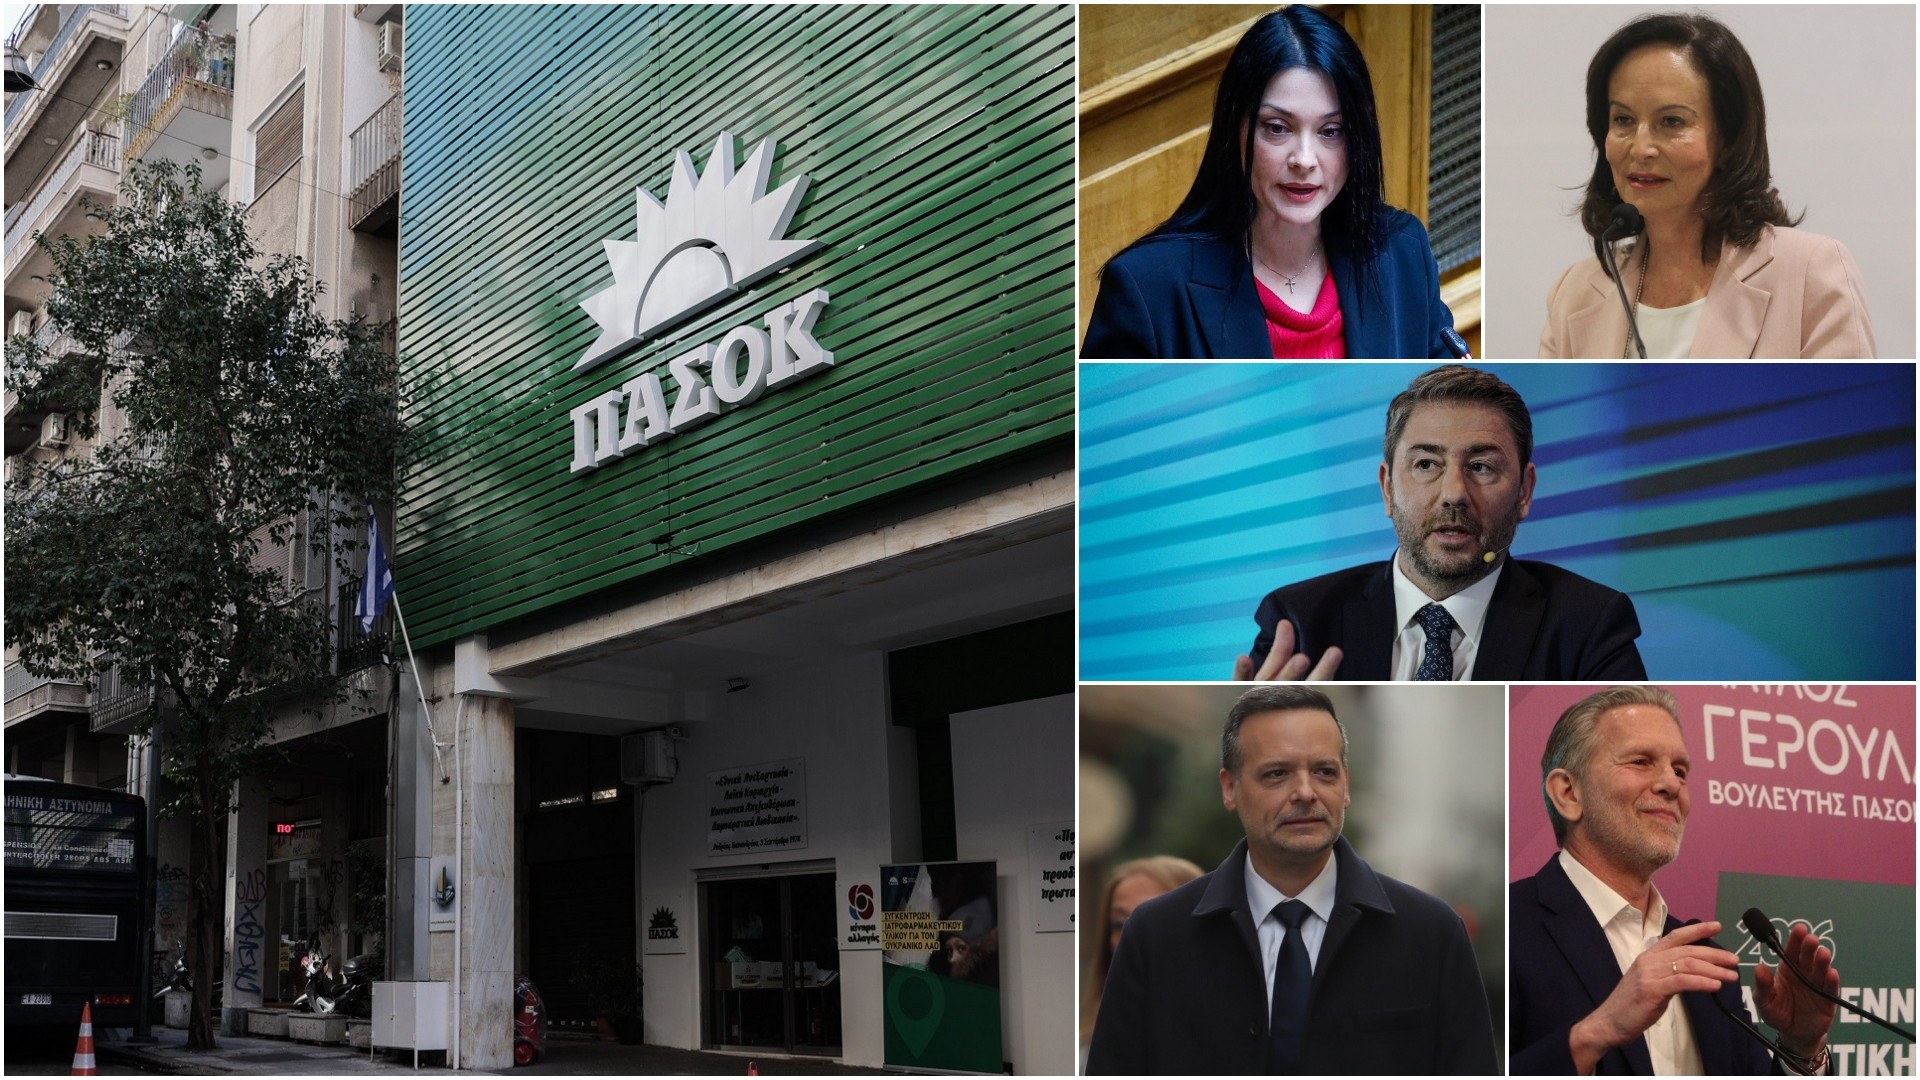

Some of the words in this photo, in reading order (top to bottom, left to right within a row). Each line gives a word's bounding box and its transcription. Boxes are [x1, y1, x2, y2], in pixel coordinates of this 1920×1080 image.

[570, 288, 833, 474] ΠΑΣΟΚ
[1703, 704, 1916, 785] ΓΕΡΟΥΛ
[743, 766, 789, 783] Ανεξαρτησία
[744, 783, 779, 799] Κυριαρχία
[1708, 779, 1847, 817] ΒΟΥΛΕΥΤΗΣ
[49, 798, 113, 814] ΑΣΤΥΝΟΜΙΑ
[710, 802, 744, 817] Κοινωνική
[745, 798, 796, 814] Απελευθέρωση
[711, 816, 755, 833] Δημοκρατική
[884, 911, 931, 921] ΣΥΓΚΕΝΤΡΩΣΗ
[849, 923, 876, 935] κίνημα
[884, 921, 962, 930] ΙΑΤΡΟΦΑΡΜΑΚΕΥΤΙΚΟΥ
[648, 928, 679, 940] ΠΑΣΟΚ
[848, 932, 880, 944] αλλαγής
[884, 931, 908, 940] ΥΛΙΚΟΥ
[908, 931, 919, 940] ΓΙΑ
[921, 931, 935, 940] ΤΟΝ
[885, 941, 923, 950] ΟΥΚΡΑΝΙΚΟ
[924, 941, 940, 950] ΛΑΟ
